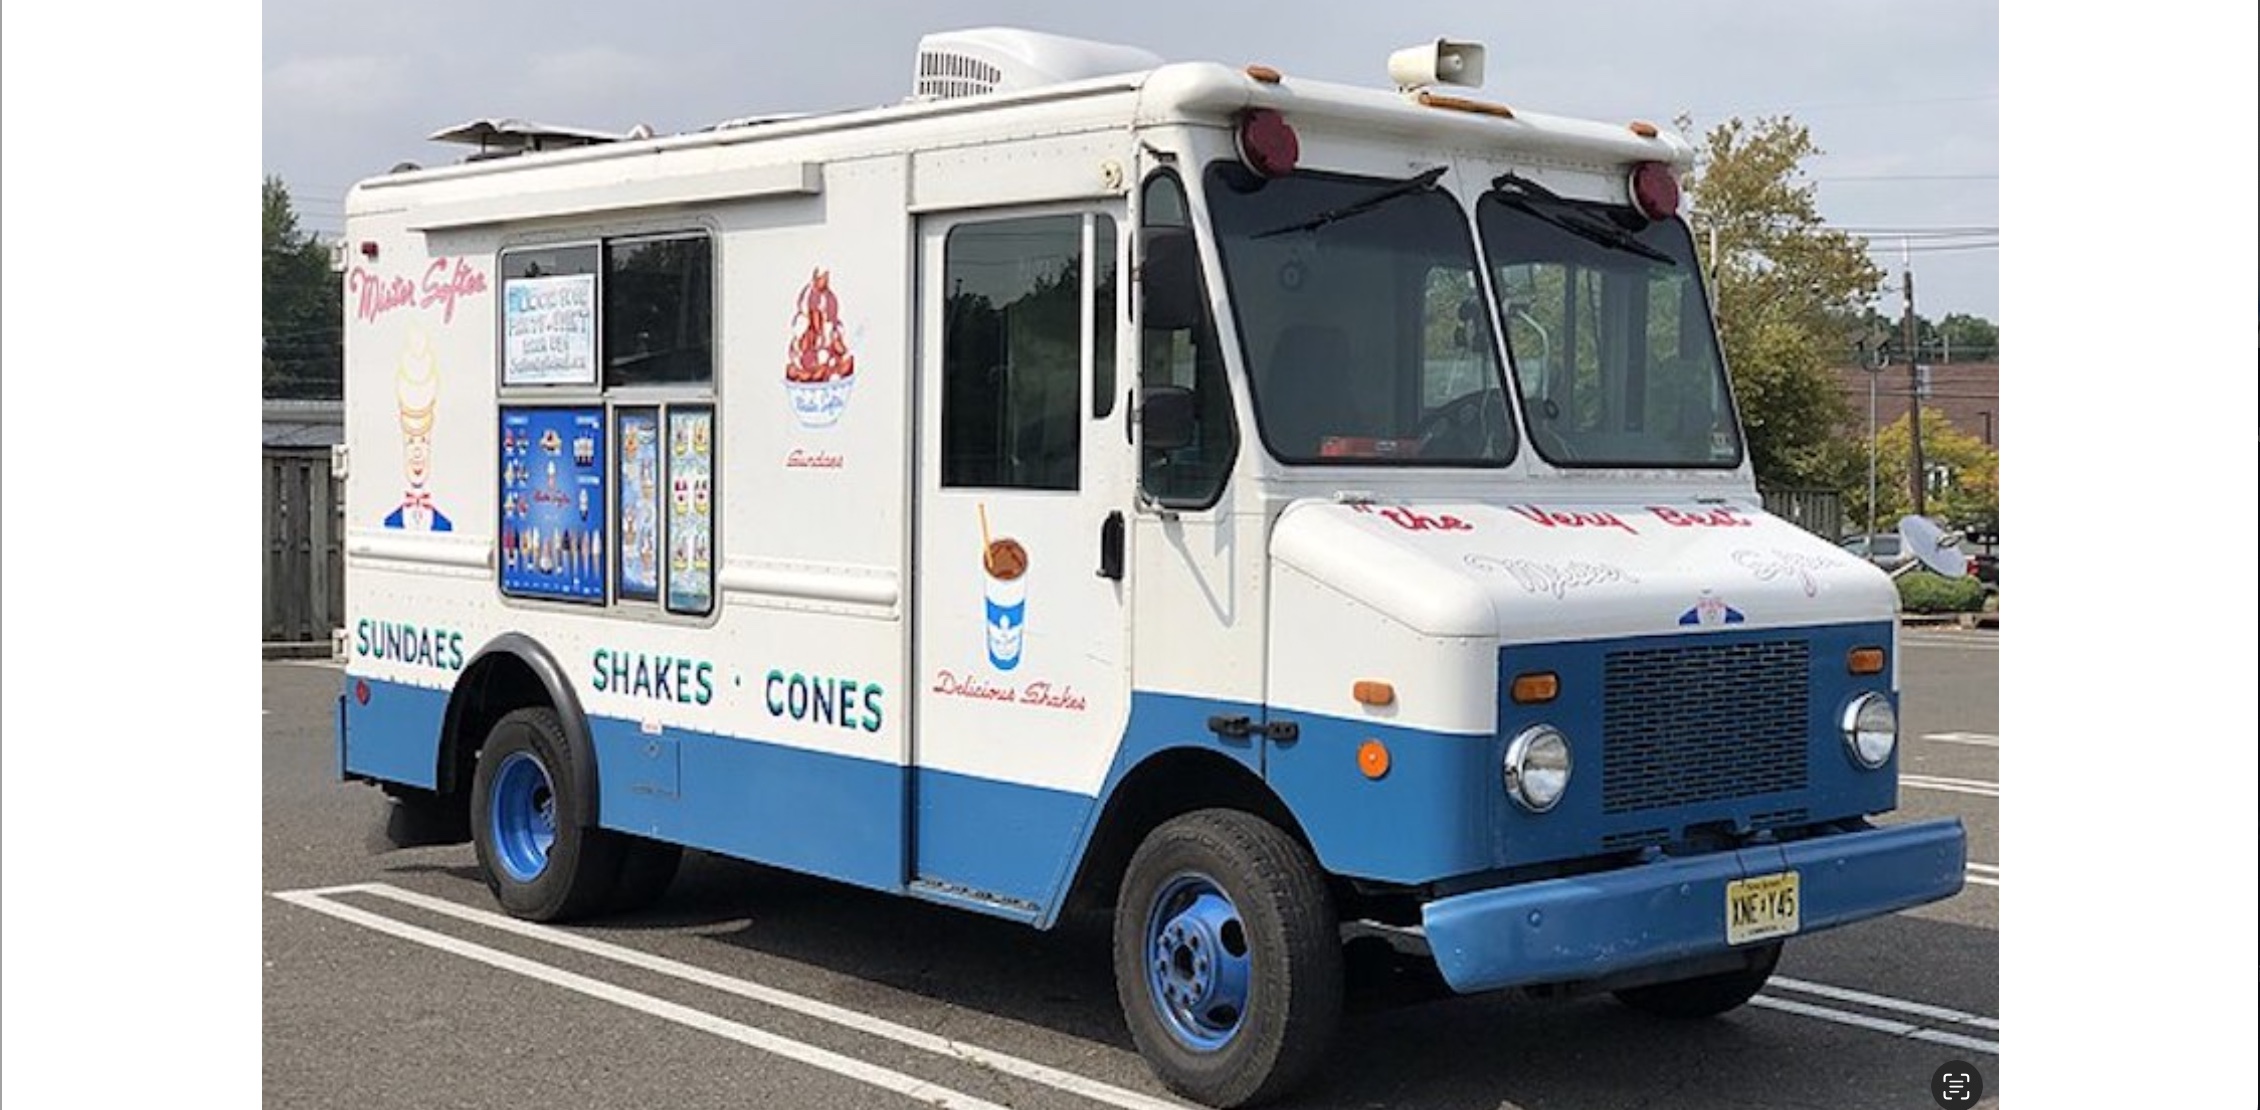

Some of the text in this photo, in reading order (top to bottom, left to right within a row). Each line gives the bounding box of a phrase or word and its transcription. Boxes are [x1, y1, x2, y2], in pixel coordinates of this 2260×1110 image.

[1507, 503, 1639, 535] Very
[356, 618, 465, 672] SUNDAES
[592, 649, 884, 734] SHAKES CONES
[933, 669, 1086, 711] Delicious Shakes
